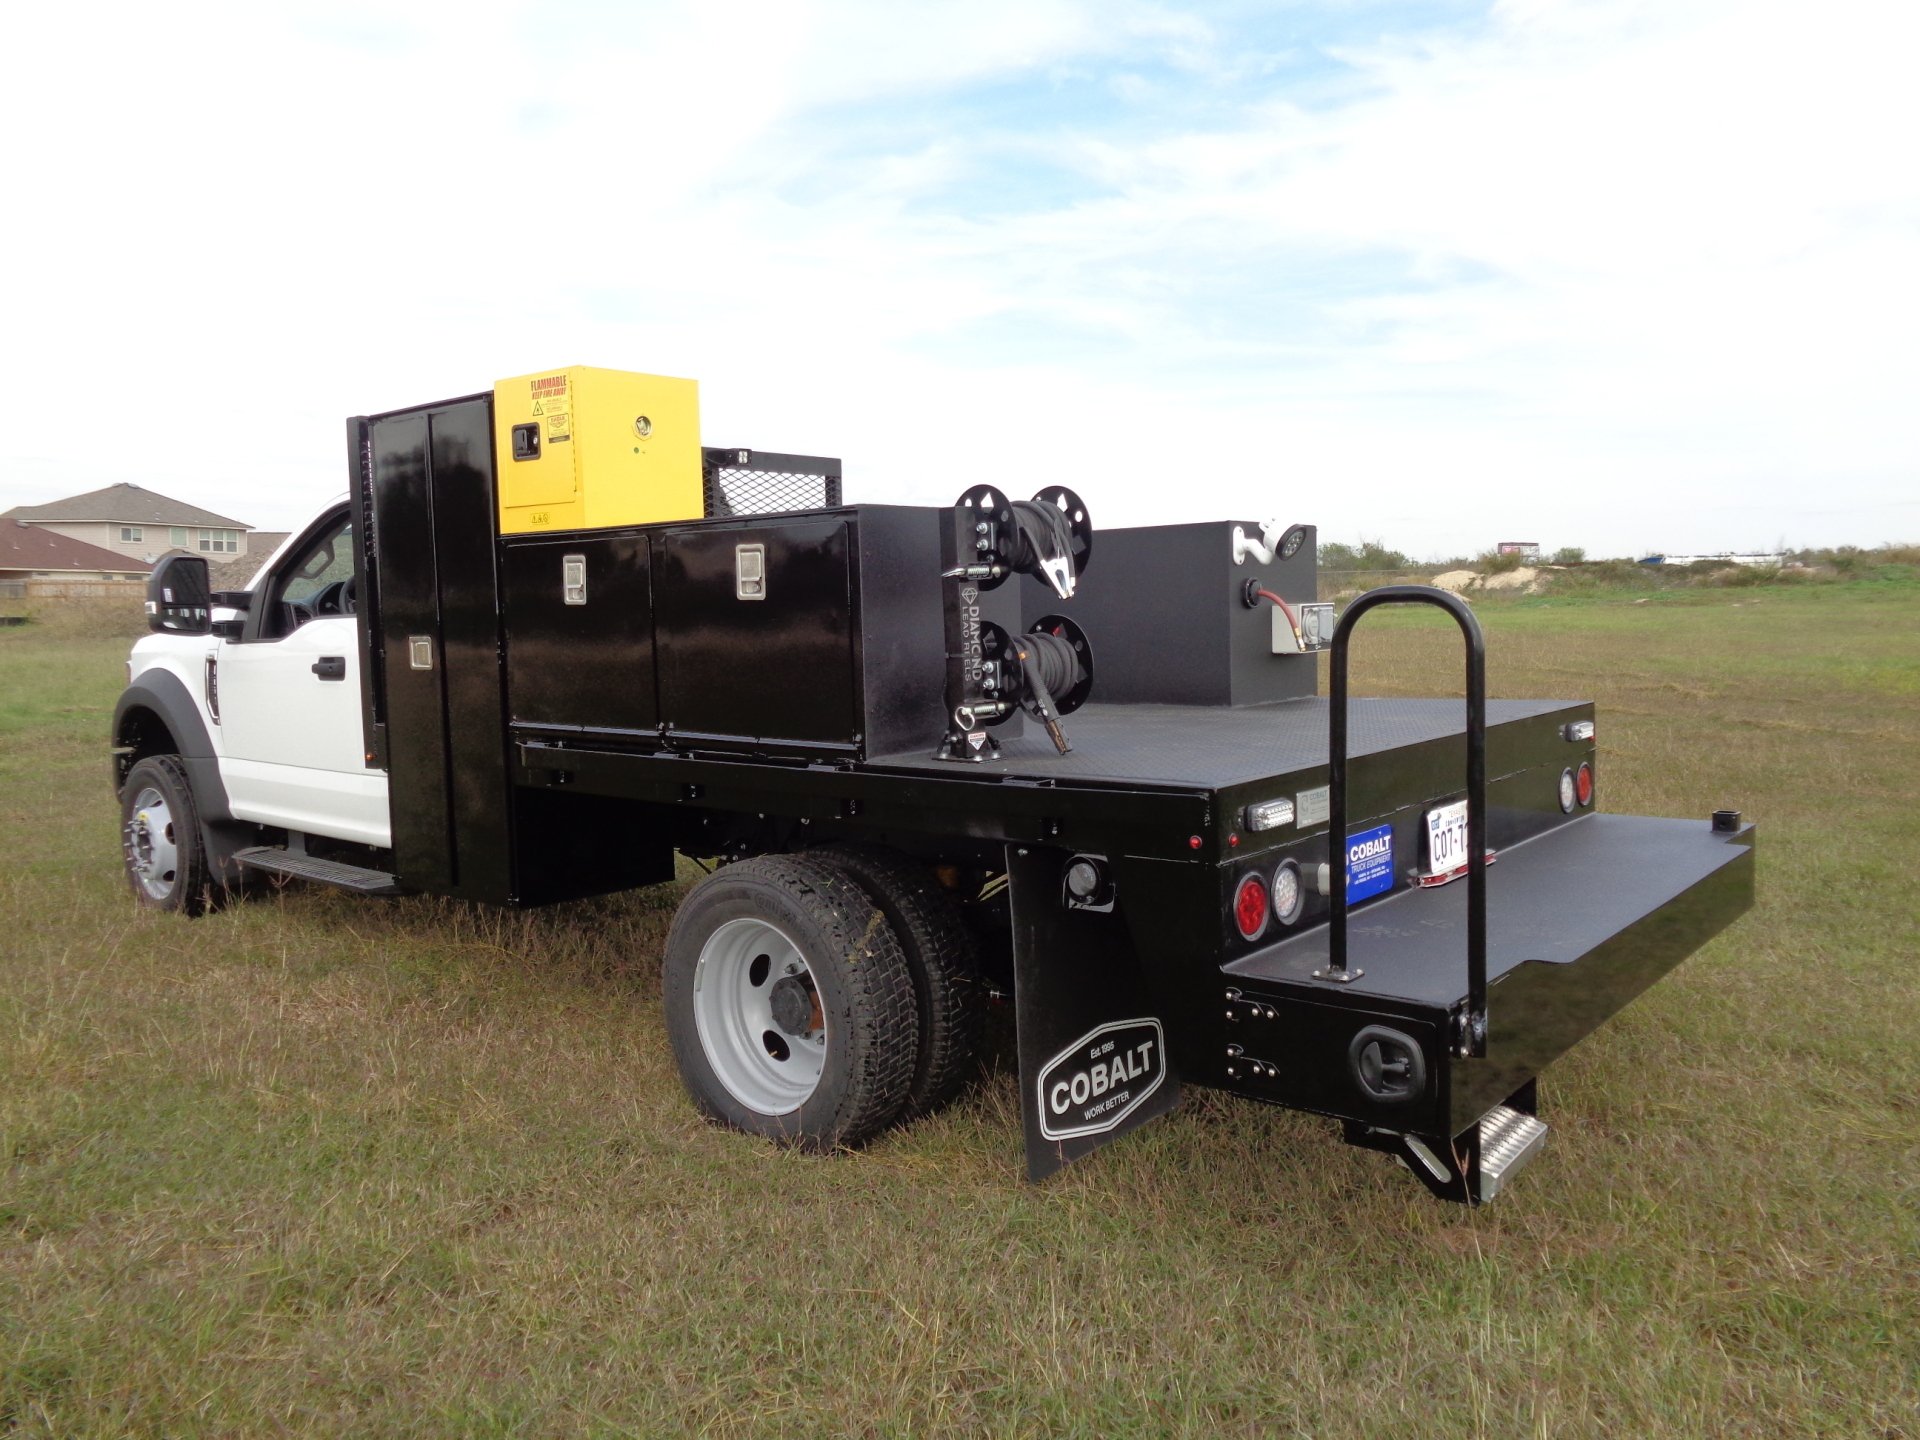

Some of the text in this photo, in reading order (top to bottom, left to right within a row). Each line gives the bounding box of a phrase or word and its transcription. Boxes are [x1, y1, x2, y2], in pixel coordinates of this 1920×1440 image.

[530, 375, 567, 391] FLAMMABLE
[532, 386, 567, 400] KEEP FIRE AWAY
[962, 606, 970, 638] LEAD
[969, 606, 982, 681] DIAMOND
[1350, 835, 1391, 862] COBALT
[1351, 861, 1367, 874] TRUCK
[1367, 853, 1391, 868] EQUIPMENT
[1051, 1041, 1153, 1115] COBALT
[1084, 1091, 1130, 1121] WORK BETTER
